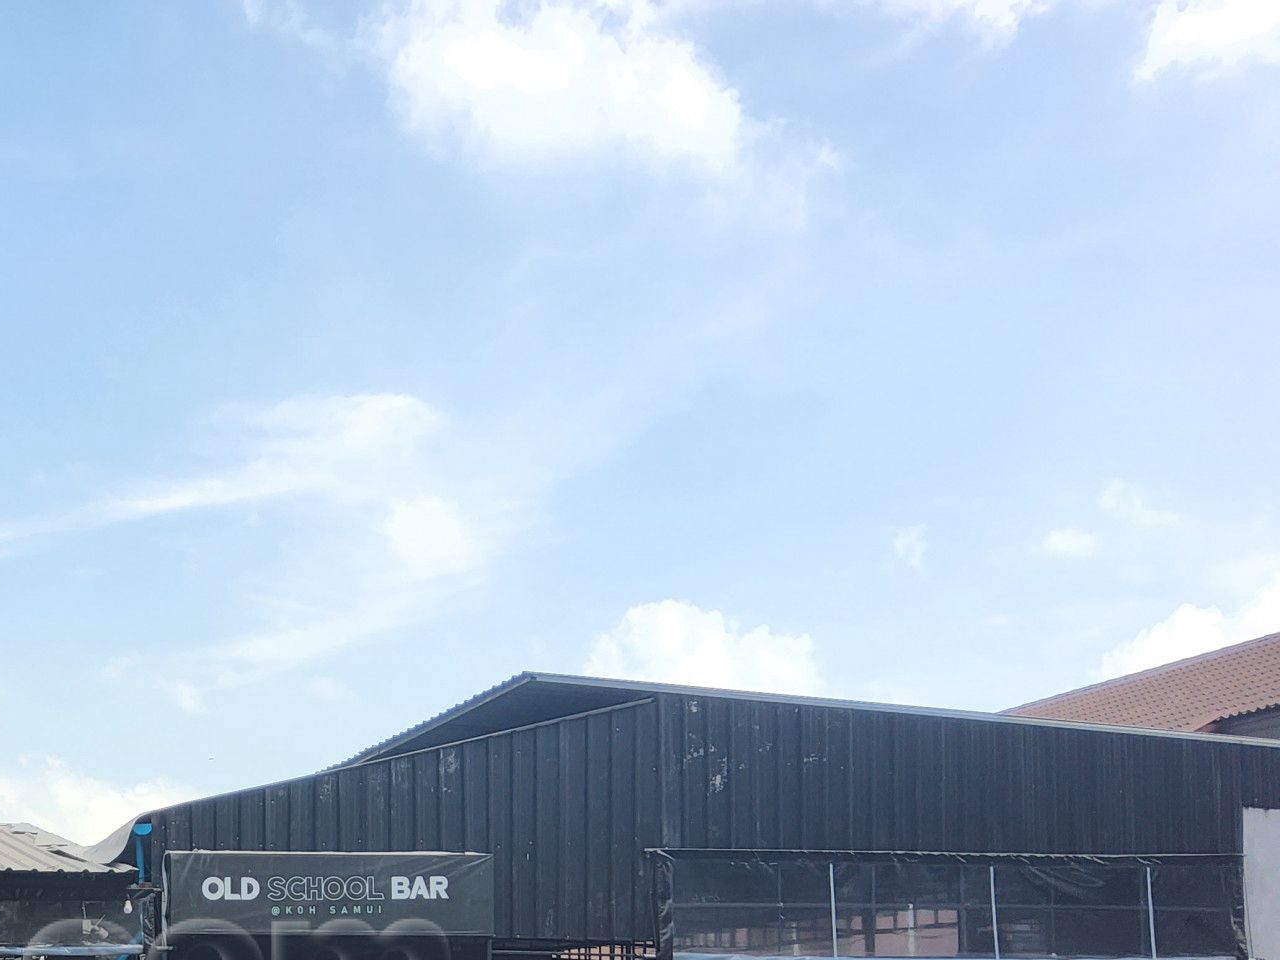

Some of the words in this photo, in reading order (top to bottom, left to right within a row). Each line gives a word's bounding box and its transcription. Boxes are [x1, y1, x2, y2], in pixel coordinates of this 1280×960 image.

[202, 876, 261, 900] OLD
[267, 876, 385, 901] SCHOOL
[391, 876, 449, 900] BAR
[271, 905, 316, 916] @KOH
[329, 905, 382, 914] SAMUI
